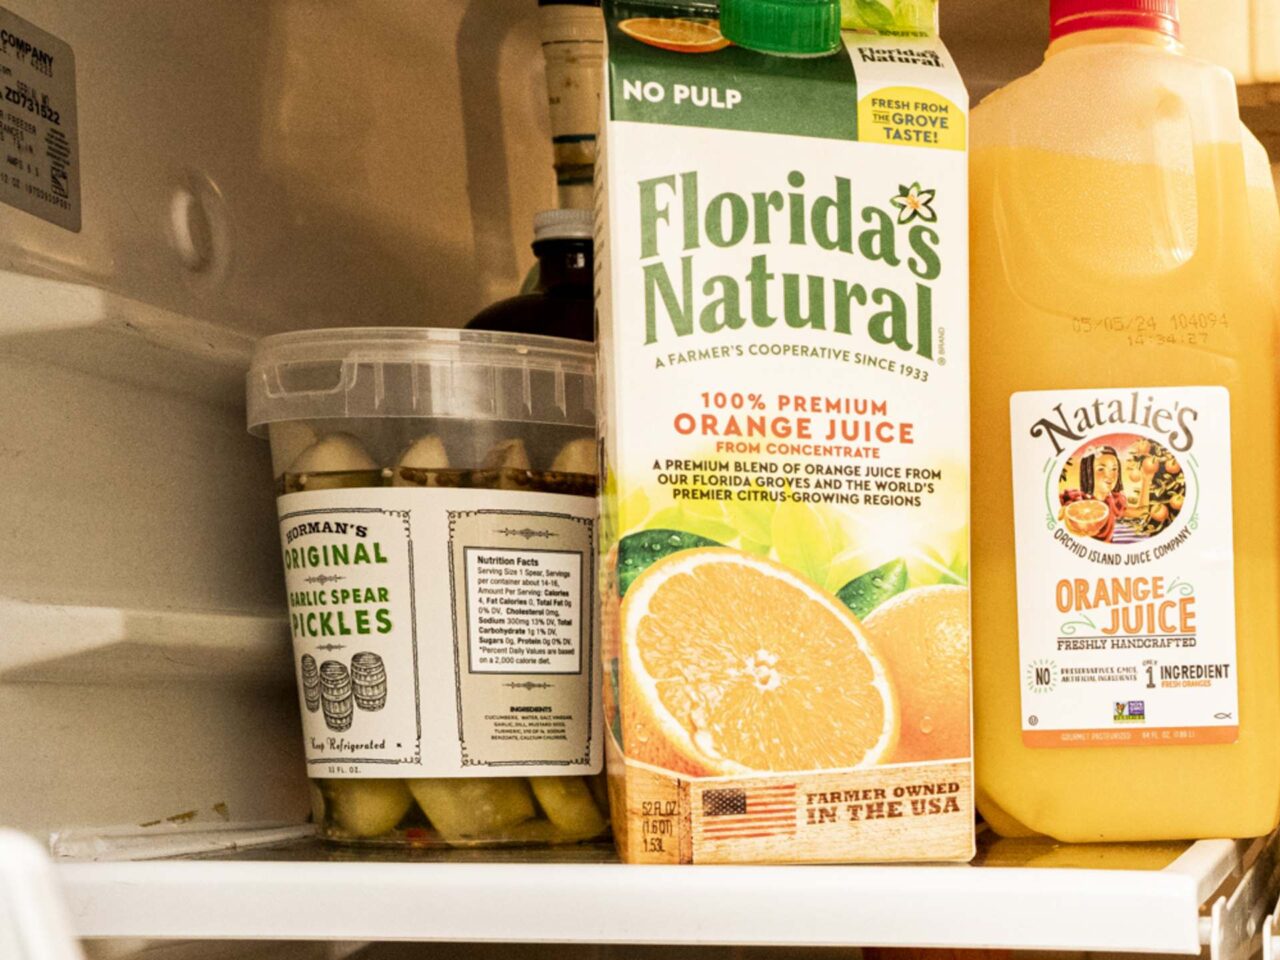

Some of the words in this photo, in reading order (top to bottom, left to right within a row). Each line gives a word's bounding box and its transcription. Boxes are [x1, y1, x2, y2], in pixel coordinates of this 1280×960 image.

[623, 79, 665, 103] NO
[674, 84, 742, 109] PULP
[871, 97, 909, 110] FRESH
[914, 102, 949, 114] FROM
[892, 113, 949, 129] GROVE
[883, 127, 938, 144] TASTE!
[642, 254, 935, 362] Natural
[668, 345, 744, 366] FARMER'S
[748, 344, 850, 362] COOPERATIVE
[855, 352, 897, 373] SINCE
[900, 364, 930, 383] 1933
[701, 391, 766, 410] 100%
[777, 395, 888, 416] PREMIUM
[673, 413, 812, 439] ORANGE
[825, 419, 915, 444] JUICE
[286, 542, 388, 570] ORIGINAL
[1053, 528, 1087, 558] ORCHID
[1087, 549, 1122, 566] ISLAND
[1124, 550, 1151, 566] JUICE
[1153, 527, 1192, 559] COMPANY
[477, 556, 513, 566] Nutrition
[516, 557, 539, 566] Facts
[331, 588, 389, 604] SPEAR
[1056, 576, 1164, 614] ORANGE
[292, 609, 393, 637] PICKLES
[1101, 597, 1197, 635] JUICE
[1057, 639, 1108, 651] FRESHLY
[1110, 638, 1197, 650] HANDCRAFTED
[1160, 664, 1230, 680] INGREDIENT
[806, 788, 887, 806] FARMER
[893, 782, 960, 798] OWNED
[806, 805, 842, 826] IN
[846, 802, 904, 823] THE
[911, 796, 961, 817] USA
